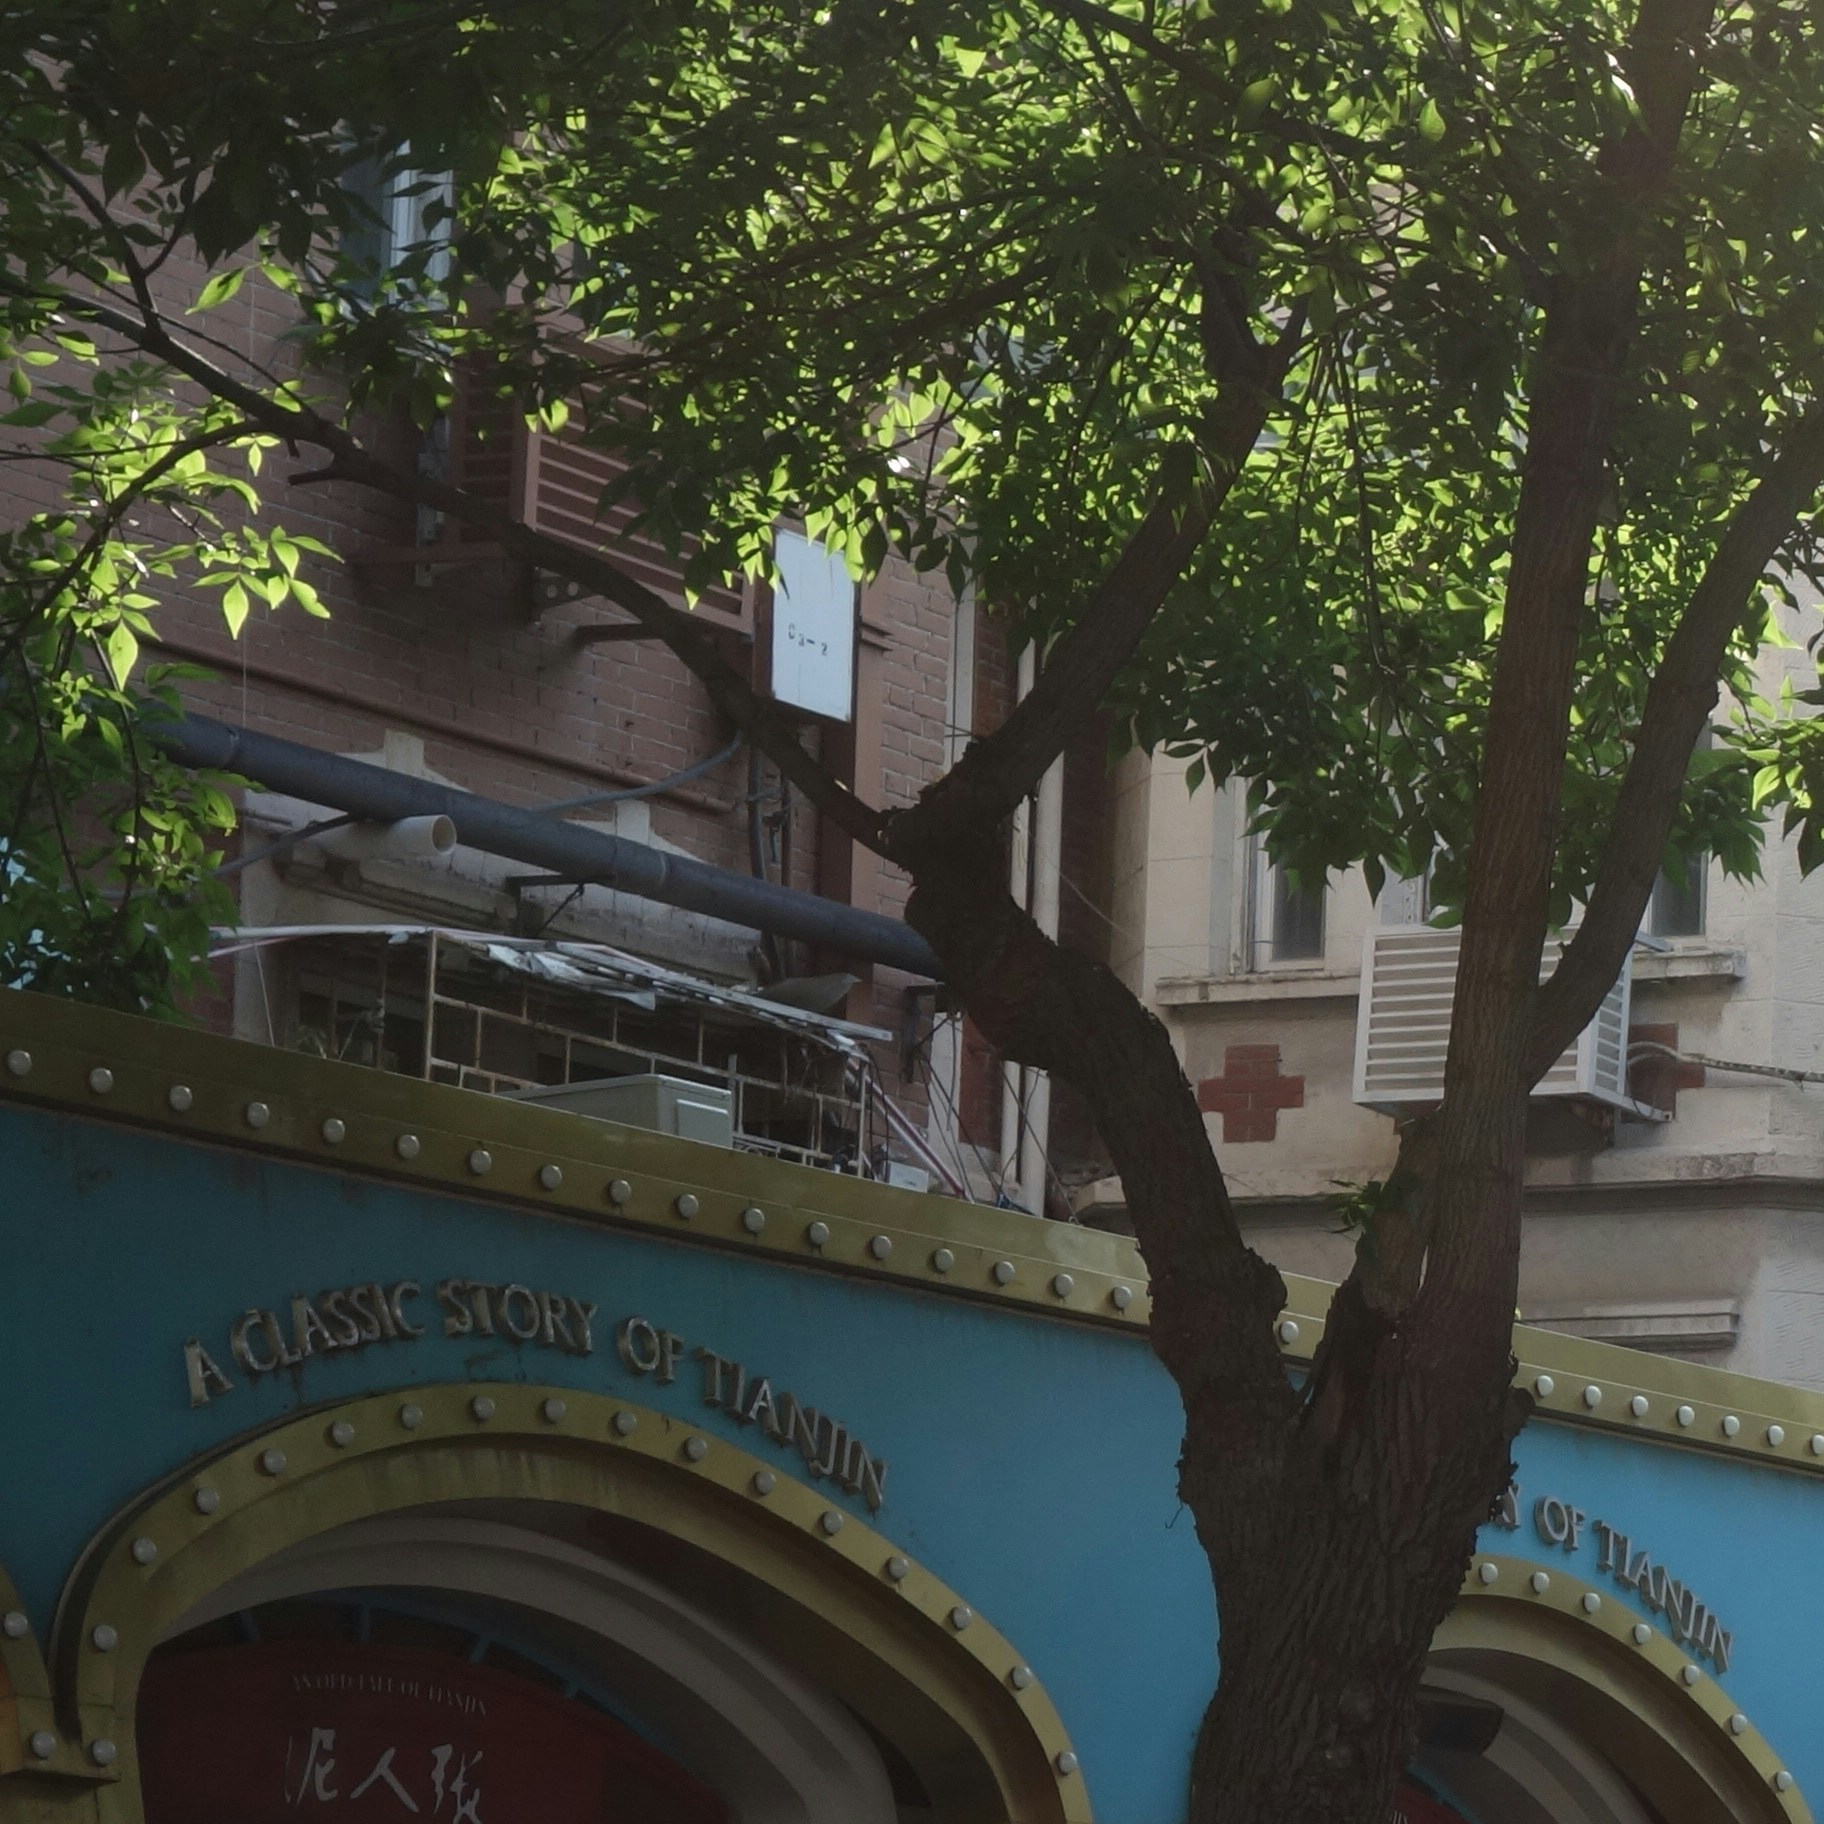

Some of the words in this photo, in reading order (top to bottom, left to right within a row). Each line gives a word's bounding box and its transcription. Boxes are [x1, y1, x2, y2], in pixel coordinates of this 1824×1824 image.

[184, 1338, 233, 1407] A
[231, 1281, 425, 1374] CLASSIC
[437, 1280, 597, 1356] STORY
[618, 1316, 684, 1384] OF
[697, 1348, 888, 1510] TIANJIN
[1534, 1496, 1586, 1551] OF
[1592, 1519, 1732, 1674] TIANJIN
